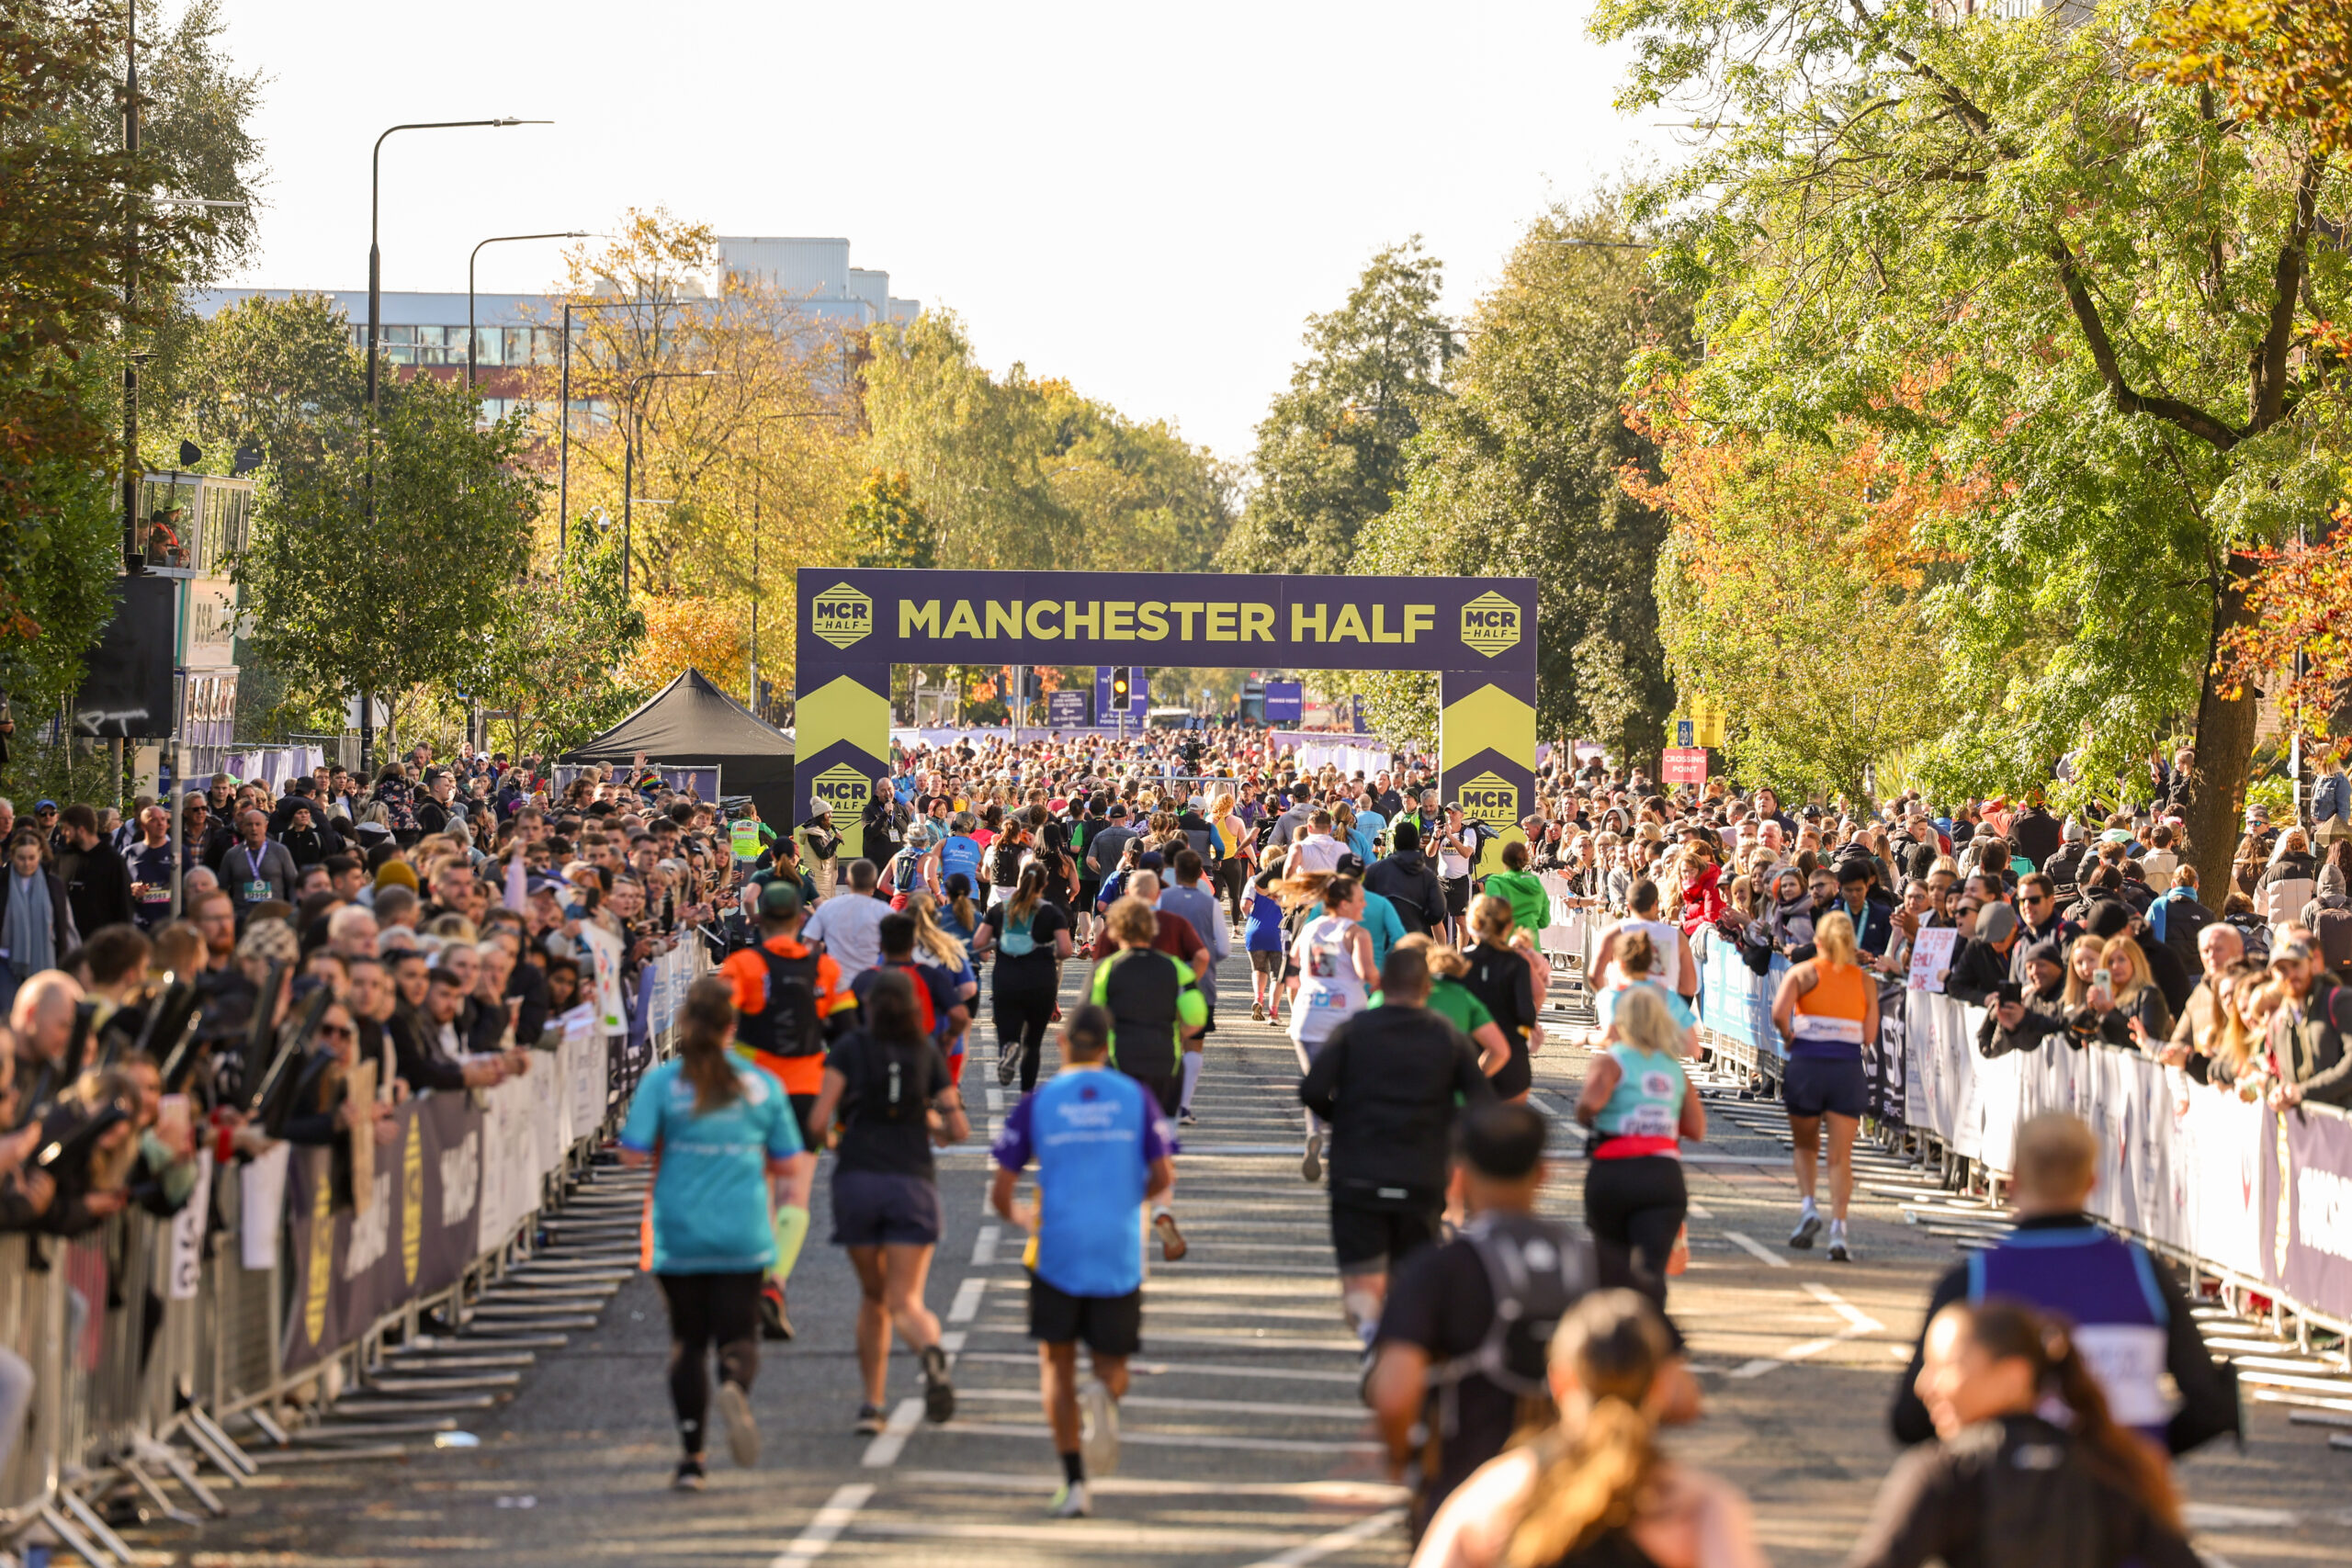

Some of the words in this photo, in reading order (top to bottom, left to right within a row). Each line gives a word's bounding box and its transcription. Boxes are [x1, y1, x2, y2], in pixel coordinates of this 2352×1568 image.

[817, 603, 867, 619] MCR
[899, 599, 1276, 642] MANCHESTER
[1291, 603, 1436, 643] HALF
[1465, 611, 1516, 627] MCR
[825, 621, 860, 629] HALF
[1474, 629, 1509, 637] HALF
[1665, 755, 1705, 763] CROSSING
[1672, 765, 1698, 773] POINT
[817, 783, 866, 799] MCR
[1463, 791, 1513, 807] MCR
[829, 801, 859, 809] ALF
[1472, 809, 1505, 818] HALF
